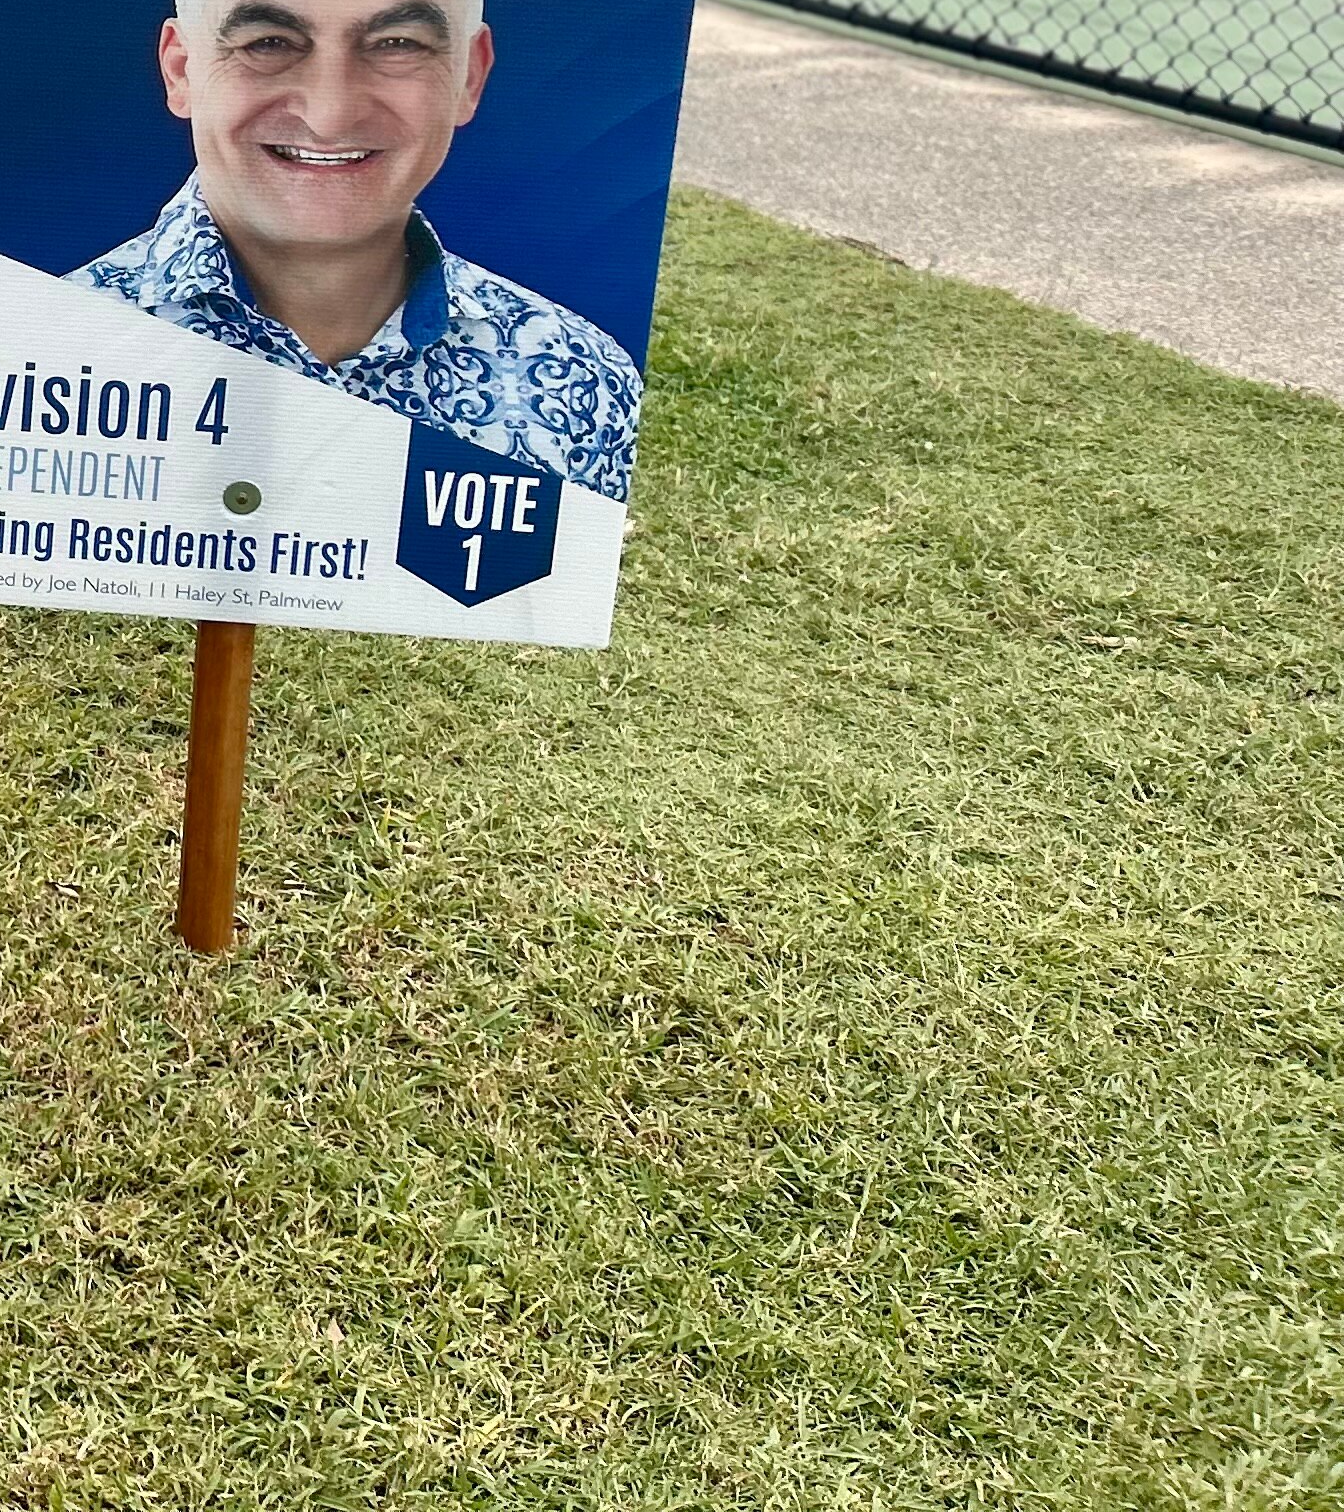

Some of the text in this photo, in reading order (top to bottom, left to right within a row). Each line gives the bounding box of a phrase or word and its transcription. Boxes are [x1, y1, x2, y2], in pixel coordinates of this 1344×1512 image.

[194, 377, 230, 446] 4
[424, 470, 540, 533] VOTE
[69, 518, 257, 573] Residents
[269, 532, 369, 581] First!
[462, 534, 483, 592] 1
[22, 573, 43, 593] by
[46, 575, 78, 595] Joe
[83, 578, 141, 598] Natoli,
[149, 582, 165, 599] 11
[175, 584, 226, 606] Haley
[232, 588, 253, 607] St,
[258, 590, 343, 612] Palmview
